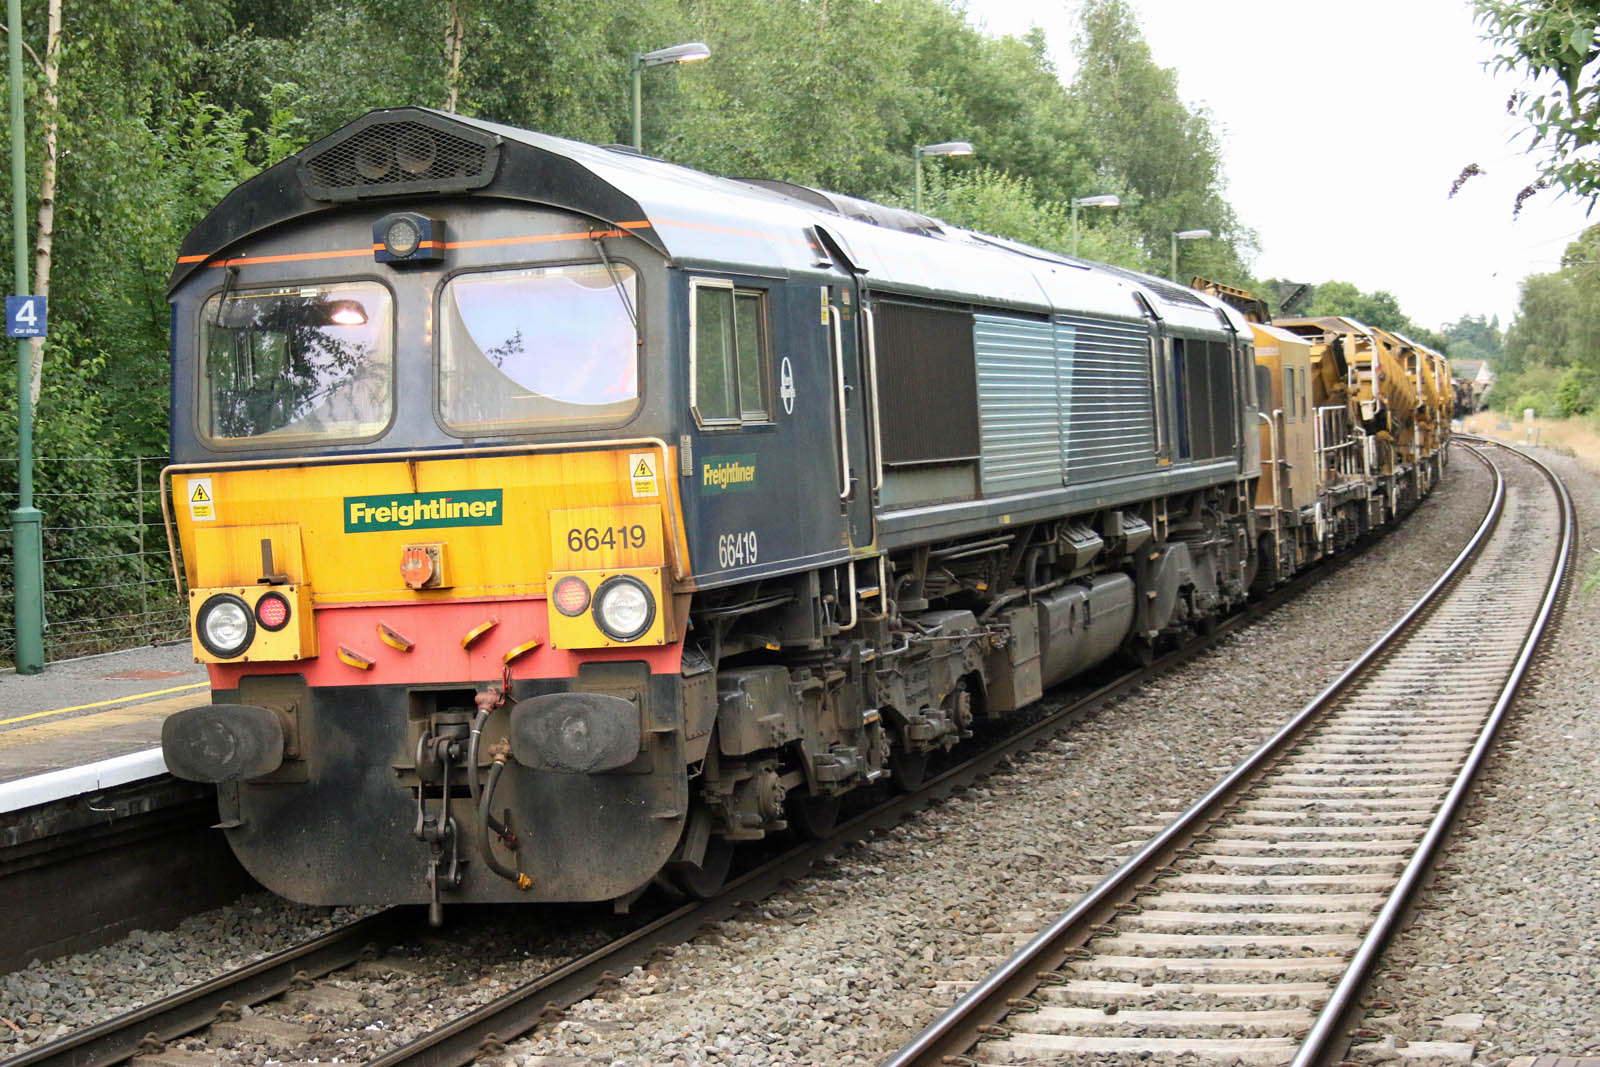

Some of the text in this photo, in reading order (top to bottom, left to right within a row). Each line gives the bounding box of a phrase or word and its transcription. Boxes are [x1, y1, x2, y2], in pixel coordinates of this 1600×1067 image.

[15, 299, 38, 327] 4
[703, 462, 755, 489] Freightliner
[350, 497, 497, 527] Freightliner
[567, 524, 646, 552] 66419
[718, 530, 758, 569] 66419
